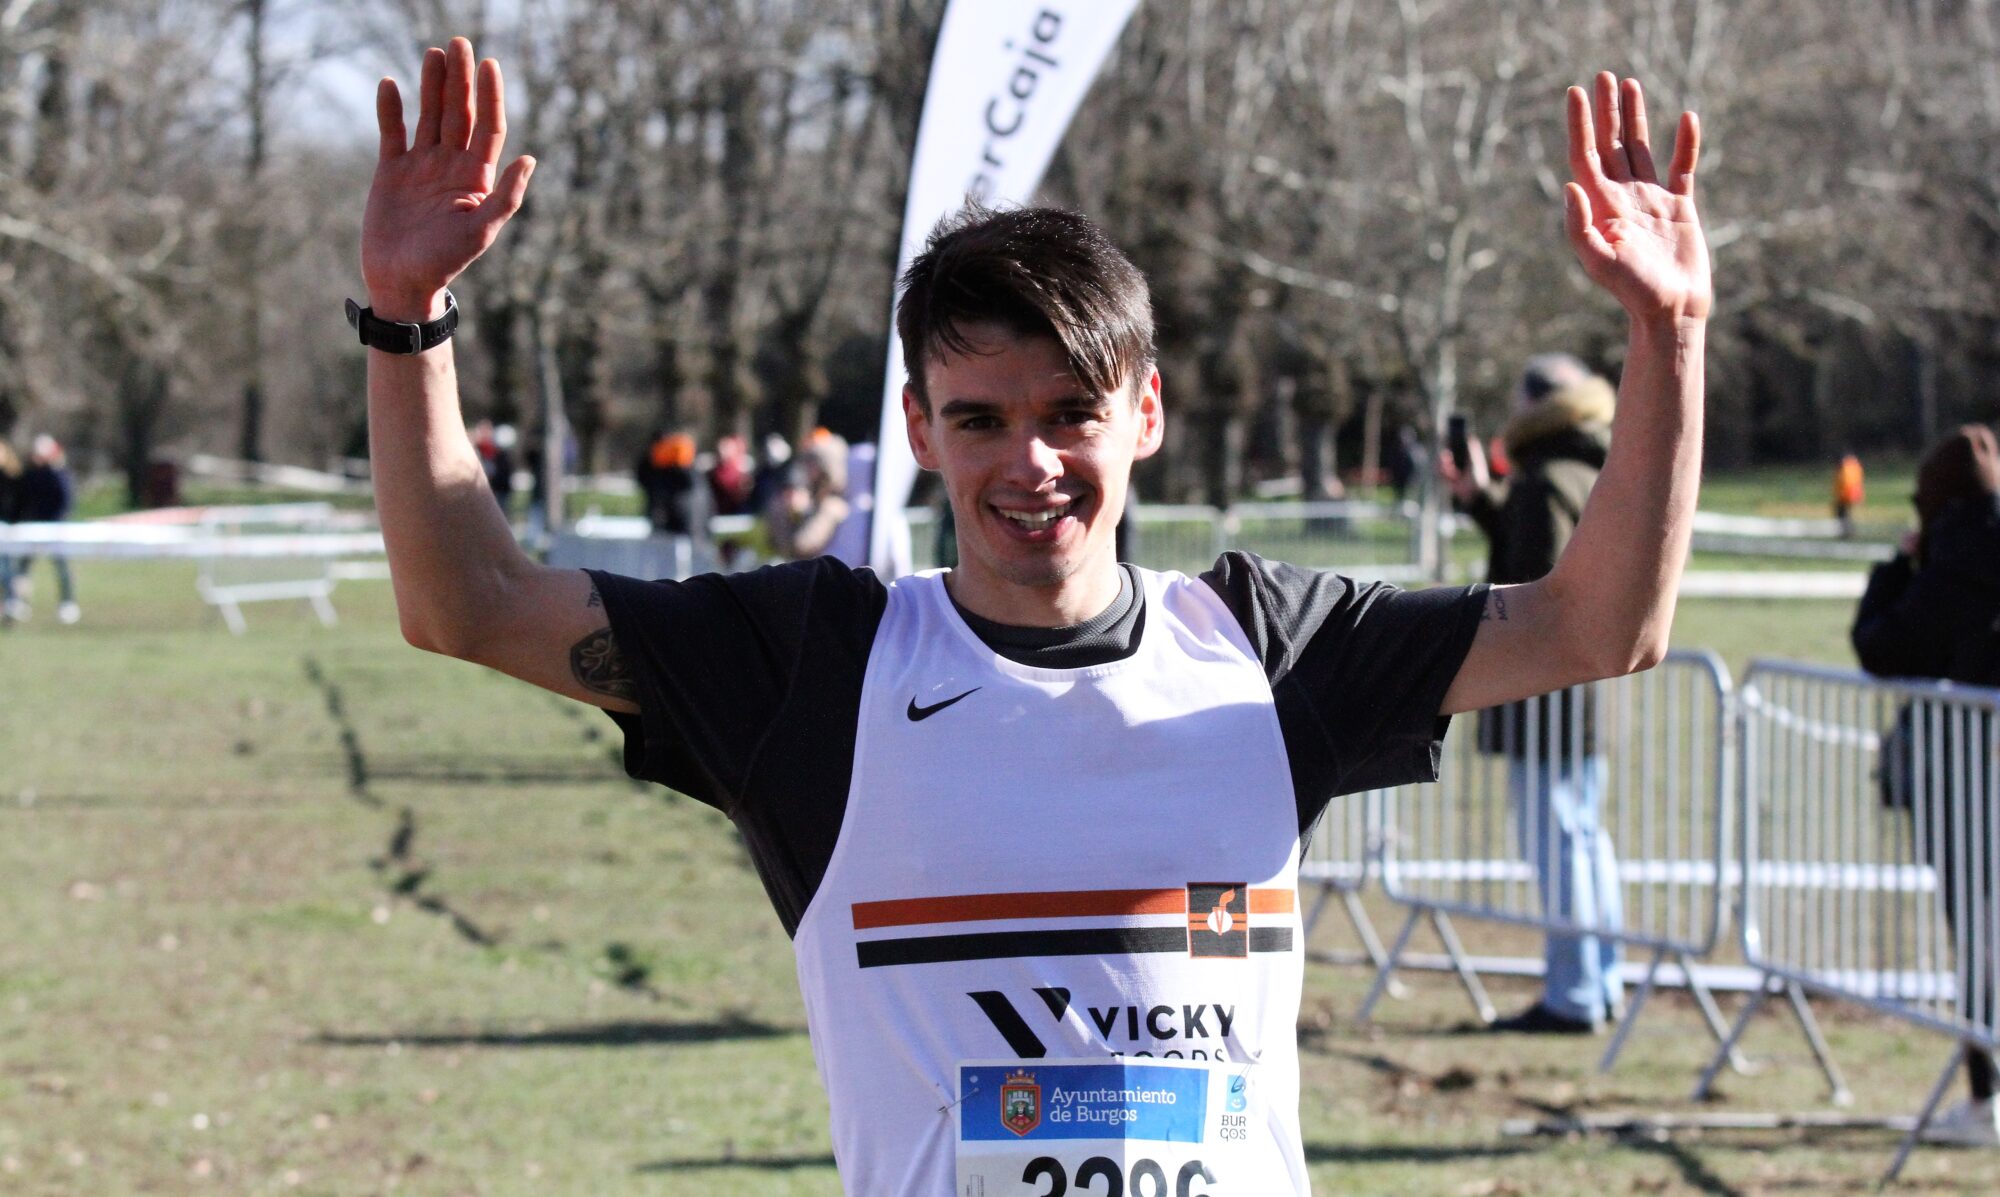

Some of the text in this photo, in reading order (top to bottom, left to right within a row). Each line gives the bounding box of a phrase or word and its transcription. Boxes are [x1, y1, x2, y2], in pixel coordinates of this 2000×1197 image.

[1087, 1003, 1236, 1042] VICKY
[1050, 1086, 1177, 1108] Ayuntamiento
[1050, 1106, 1138, 1126] de Burgos
[1221, 1114, 1247, 1127] BUR
